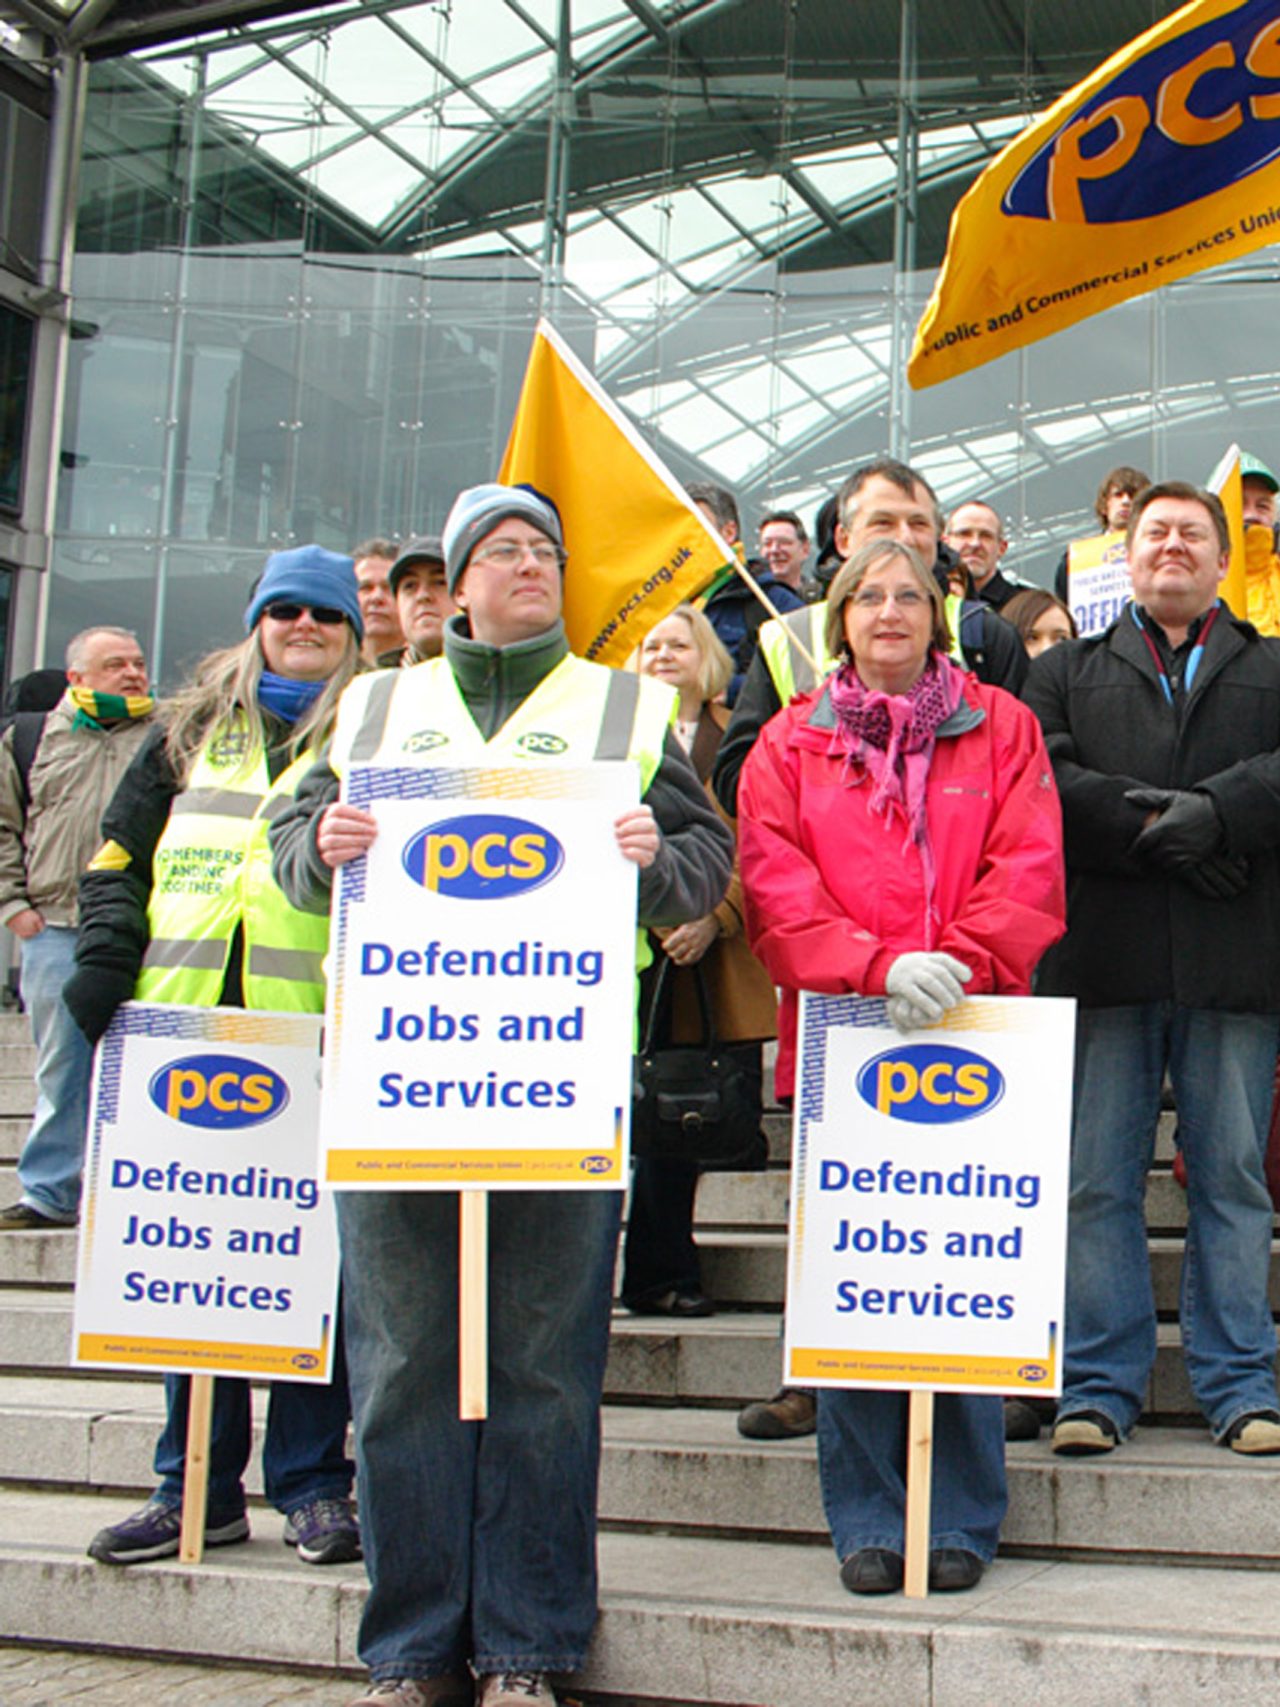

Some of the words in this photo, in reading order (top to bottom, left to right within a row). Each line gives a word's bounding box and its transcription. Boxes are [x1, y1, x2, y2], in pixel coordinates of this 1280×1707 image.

[987, 304, 1024, 332] and
[1025, 262, 1149, 314] Commercial
[1154, 228, 1236, 268] Services
[585, 547, 693, 659] www.pcs.org.uk
[524, 735, 566, 753] pcs
[163, 864, 227, 880] ANDING
[173, 847, 244, 865] MEMBERS
[423, 832, 547, 893] pcs
[360, 941, 604, 986] Defending
[375, 1005, 480, 1041] Jobs
[497, 1006, 584, 1041] and
[166, 1068, 274, 1120] pcs
[378, 1071, 576, 1108] Services
[877, 1061, 990, 1116] pcs
[111, 1159, 319, 1210] Defending
[819, 1159, 1041, 1208] Defending
[123, 1215, 212, 1250] Jobs
[227, 1225, 302, 1256] and
[833, 1219, 928, 1255] Jobs
[944, 1226, 1023, 1260] and
[123, 1271, 292, 1312] Services
[835, 1280, 1015, 1320] Services
